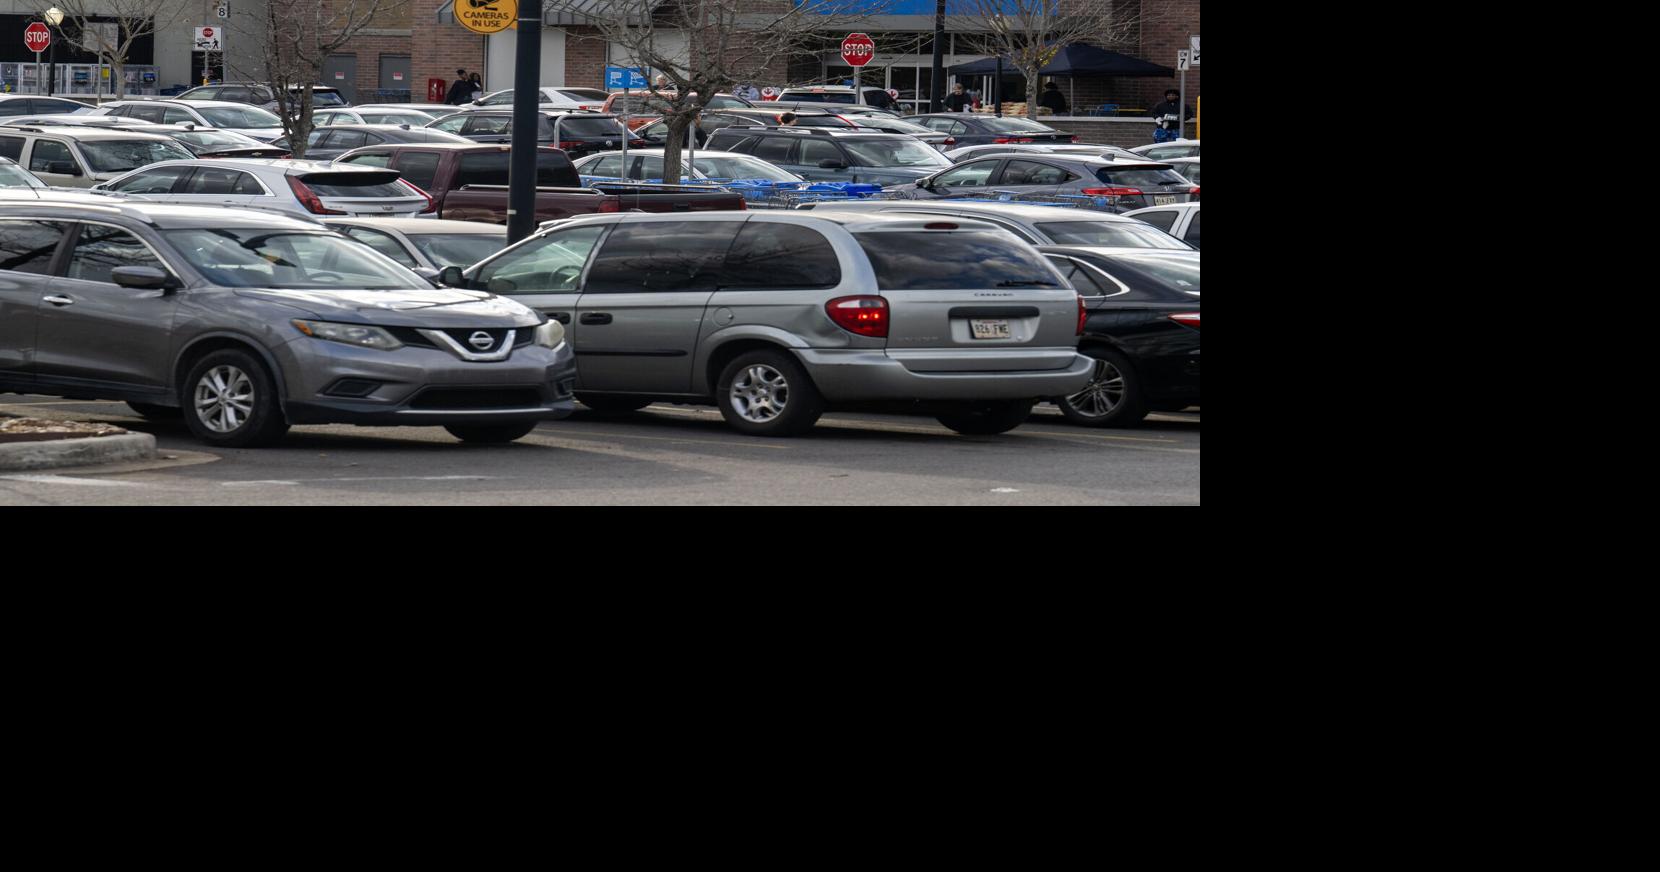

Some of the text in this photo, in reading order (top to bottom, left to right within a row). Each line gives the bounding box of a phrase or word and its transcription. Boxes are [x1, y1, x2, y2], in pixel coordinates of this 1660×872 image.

[218, 7, 226, 17] 8
[463, 11, 509, 20] CAMERAS
[483, 20, 501, 28] USE
[26, 31, 49, 43] STOP
[844, 43, 872, 56] STOP
[1180, 58, 1186, 68] 7
